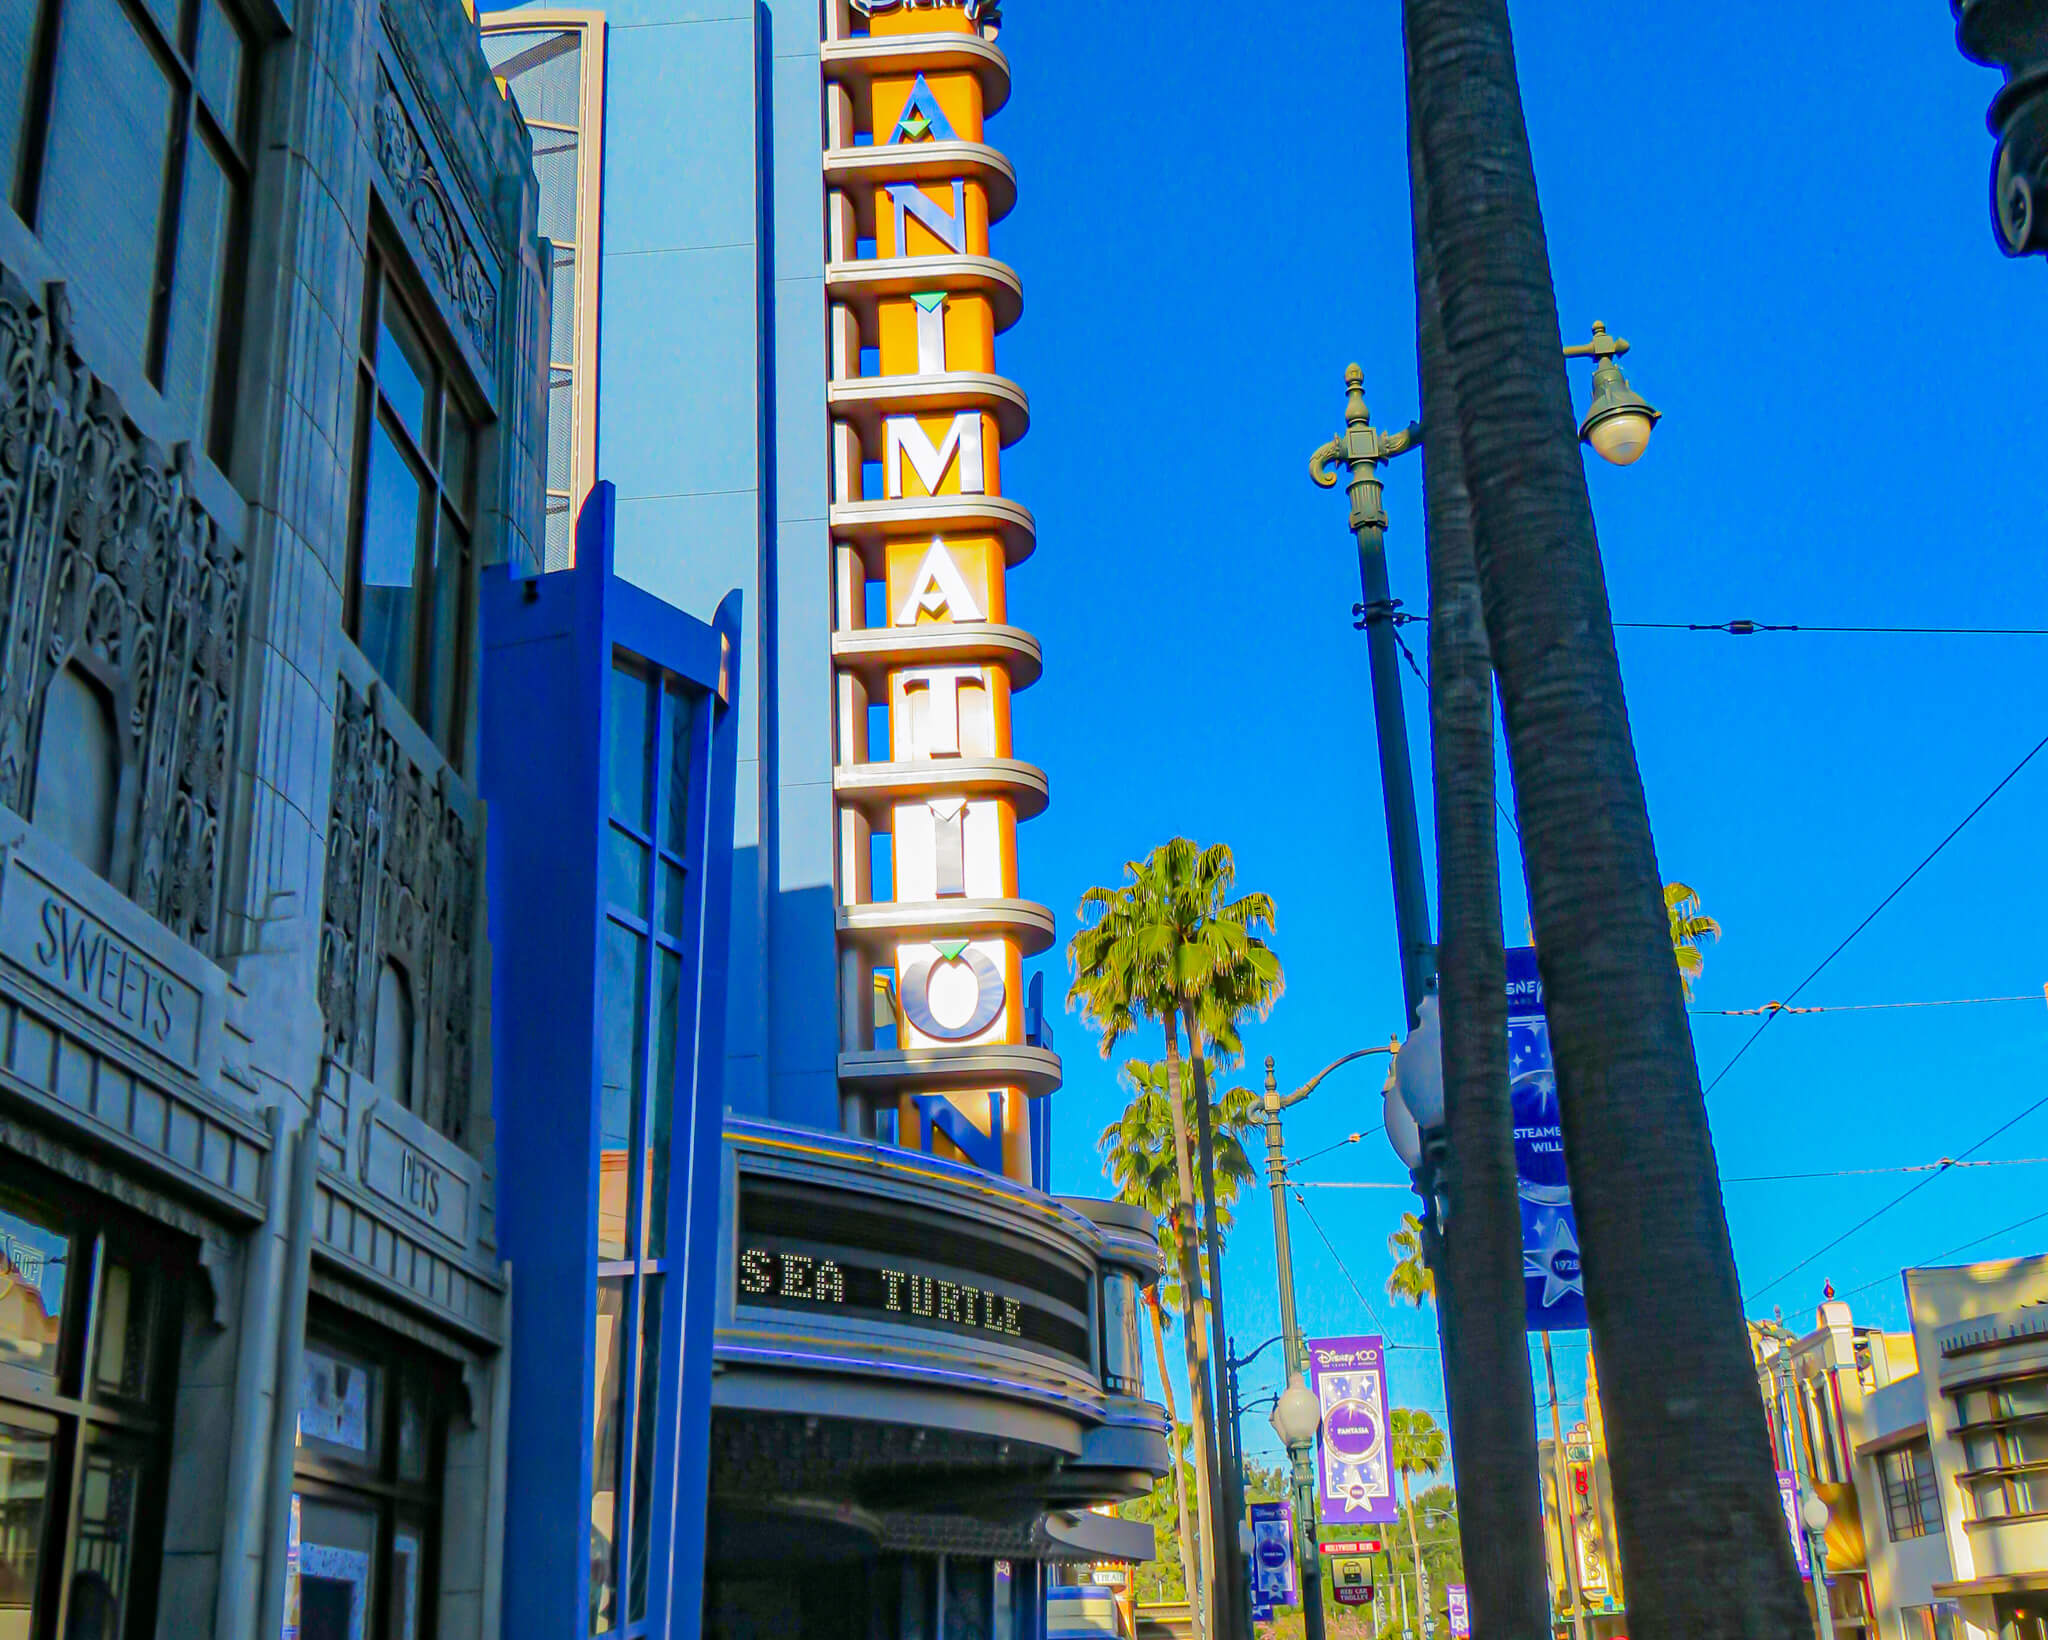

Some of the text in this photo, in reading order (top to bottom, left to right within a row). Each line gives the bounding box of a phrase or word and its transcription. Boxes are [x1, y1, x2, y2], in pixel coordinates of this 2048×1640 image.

[884, 69, 1006, 1177] ANIMATION
[36, 898, 173, 1042] SWEETS
[401, 1149, 440, 1217] PETS
[741, 1249, 1022, 1337] SEA TURTLE
[1314, 1349, 1356, 1367] Disney
[1356, 1350, 1378, 1361] 100
[1337, 1426, 1370, 1435] FANTASIA
